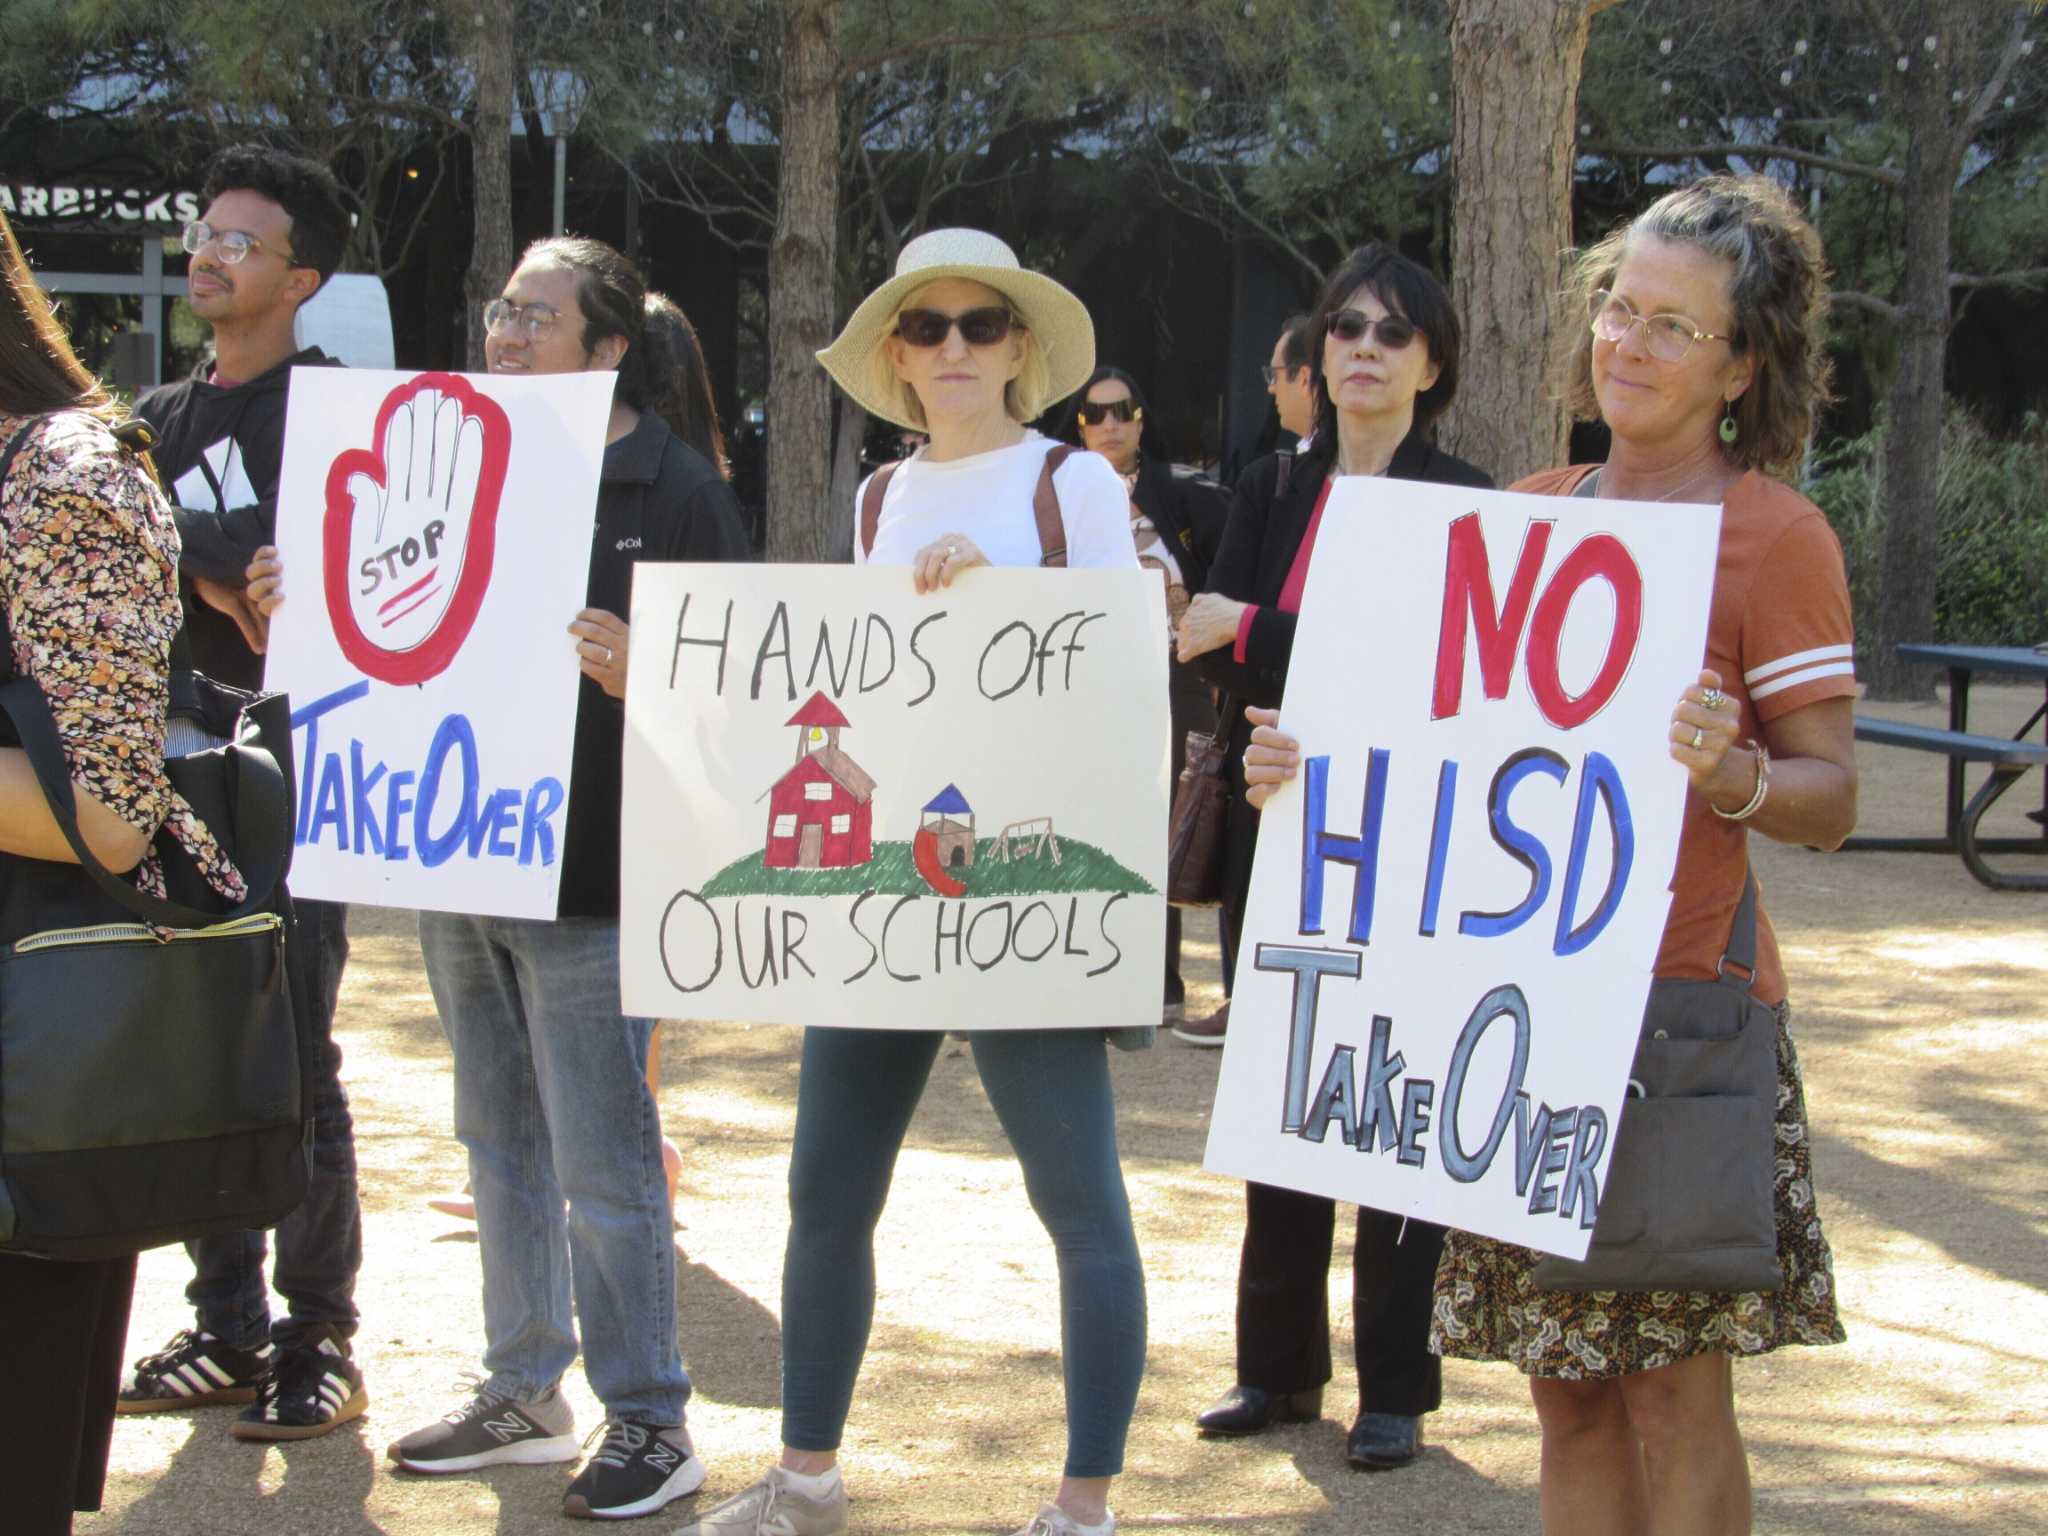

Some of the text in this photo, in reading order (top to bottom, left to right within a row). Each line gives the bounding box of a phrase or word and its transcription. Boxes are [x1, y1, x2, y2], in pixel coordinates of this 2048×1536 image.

[361, 519, 446, 595] STOP
[1430, 509, 1644, 730] NO
[670, 593, 948, 707] HANDS
[291, 680, 564, 867] TAKEOVER
[1299, 747, 1636, 956] HISD
[659, 889, 1129, 992] OUR SCHOOLS
